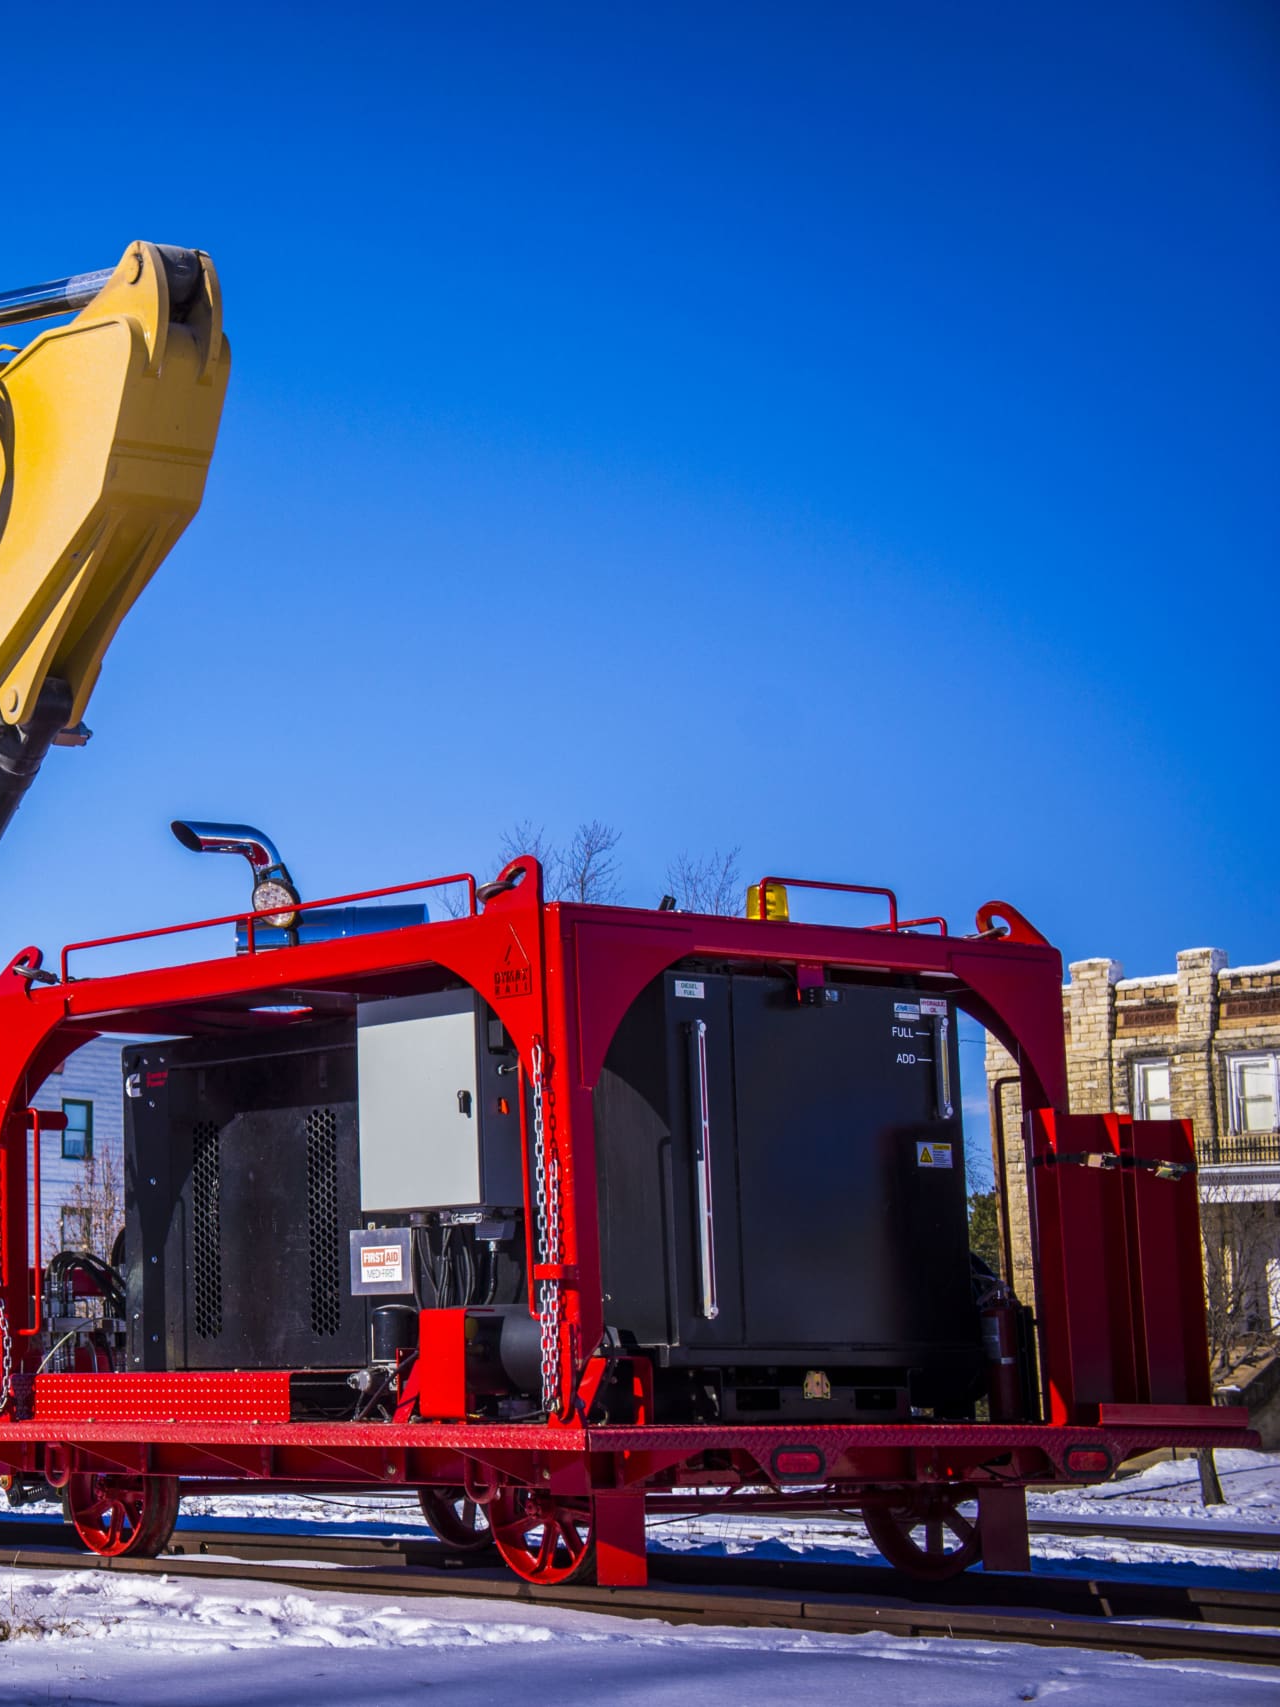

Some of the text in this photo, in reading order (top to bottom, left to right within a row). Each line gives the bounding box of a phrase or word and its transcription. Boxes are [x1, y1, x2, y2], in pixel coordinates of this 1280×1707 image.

[892, 1026, 914, 1038] FULL
[896, 1053, 916, 1065] ADD
[363, 1250, 399, 1264] FIRST AID
